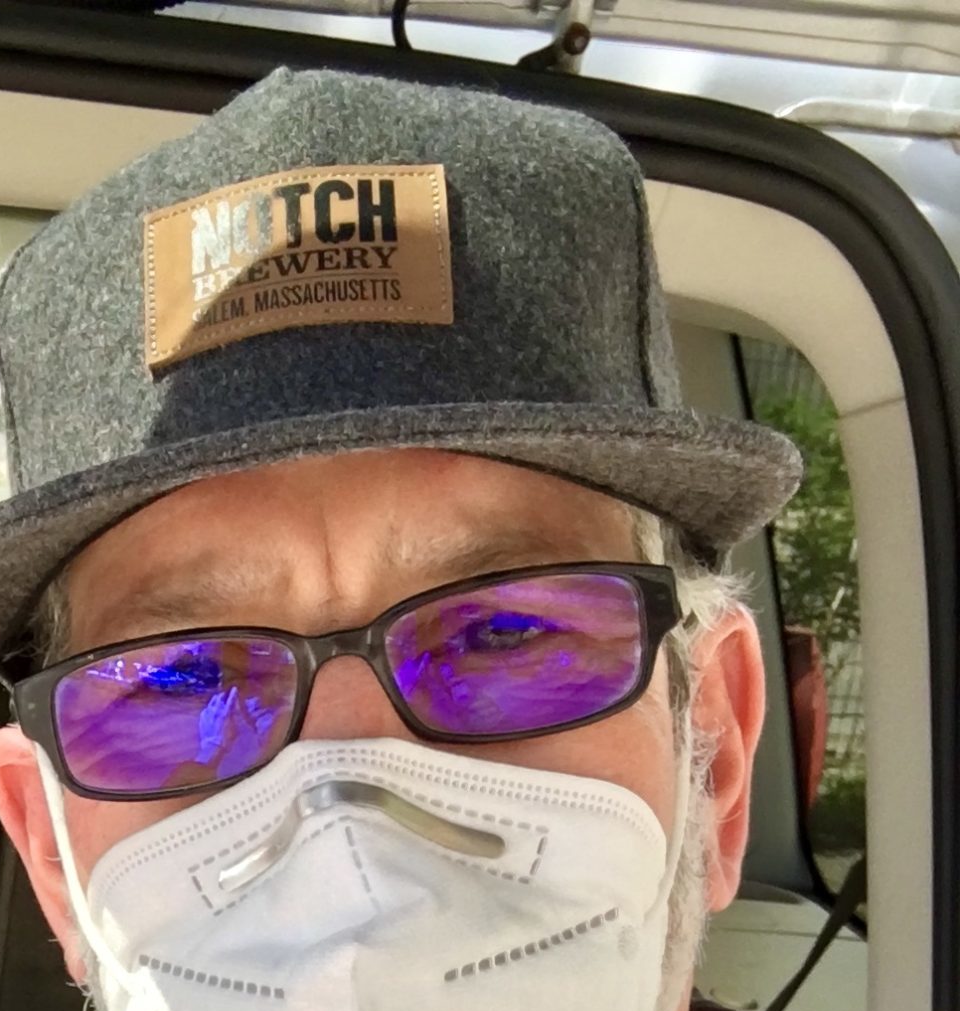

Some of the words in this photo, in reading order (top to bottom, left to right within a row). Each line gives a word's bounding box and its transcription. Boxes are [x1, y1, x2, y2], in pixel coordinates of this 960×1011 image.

[191, 179, 398, 274] NOTCH
[192, 246, 398, 301] BREWERY
[253, 278, 401, 313] MASSACHUSETTS
